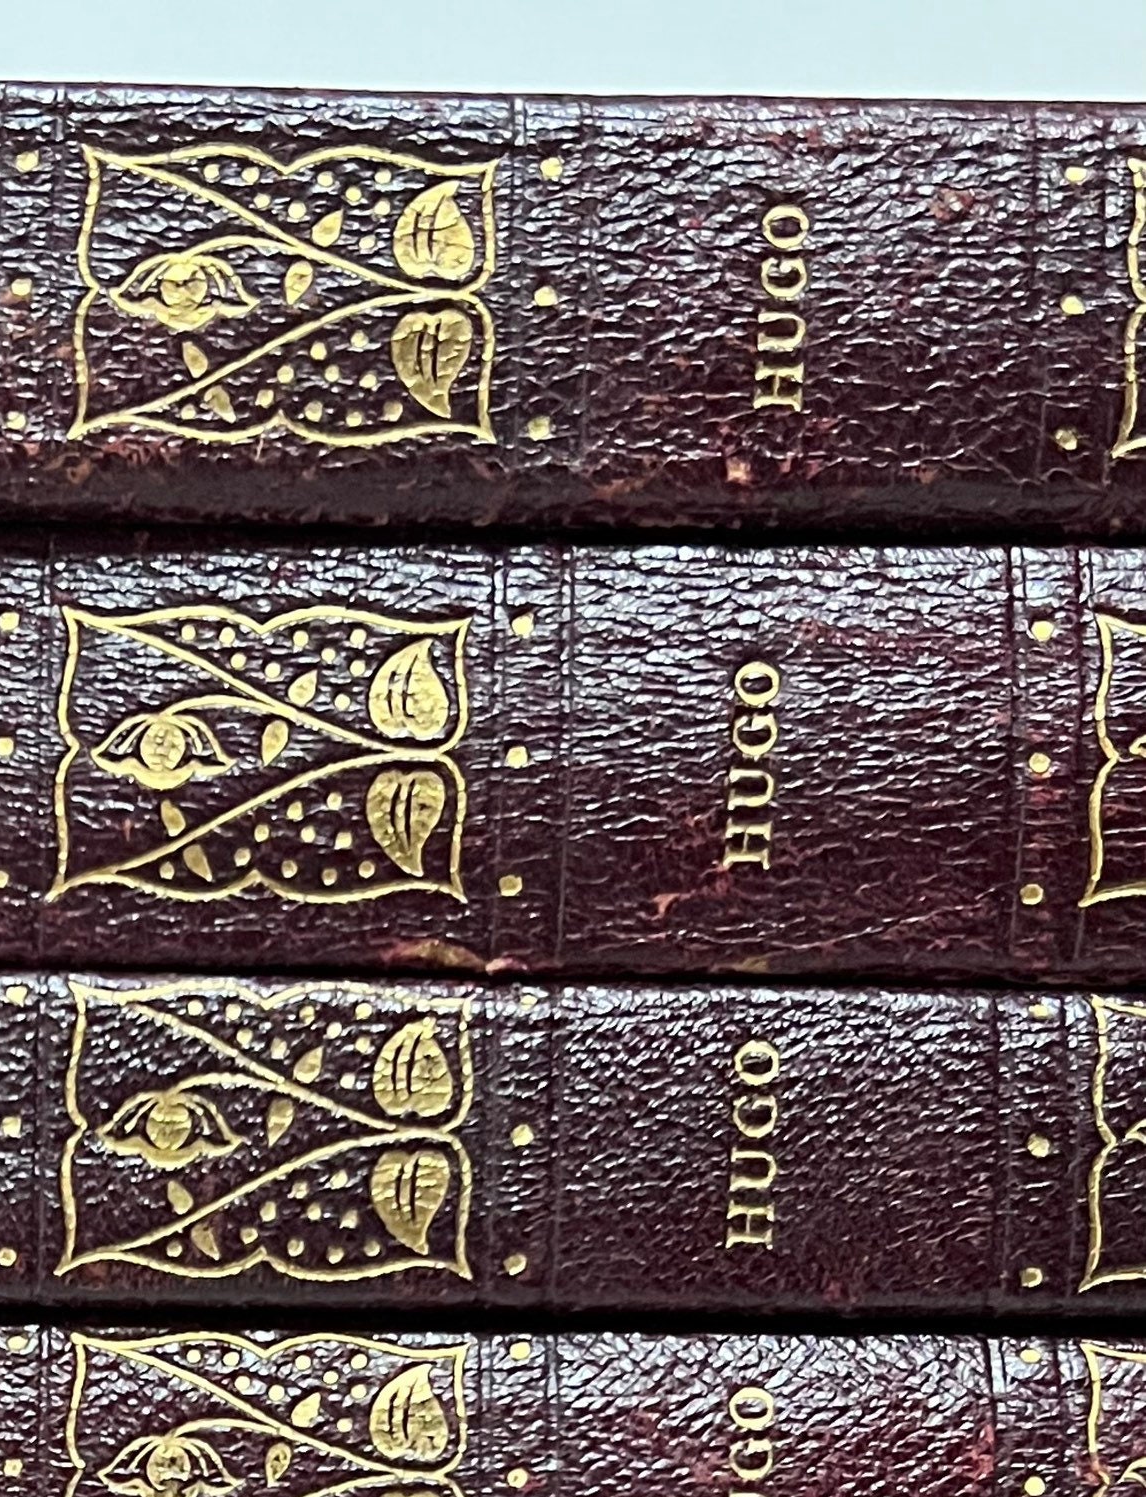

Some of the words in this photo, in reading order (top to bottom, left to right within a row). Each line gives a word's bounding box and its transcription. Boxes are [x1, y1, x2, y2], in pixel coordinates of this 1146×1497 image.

[753, 202, 810, 413] HUGO
[730, 661, 781, 870] HUGO
[727, 1040, 783, 1251] HUGO
